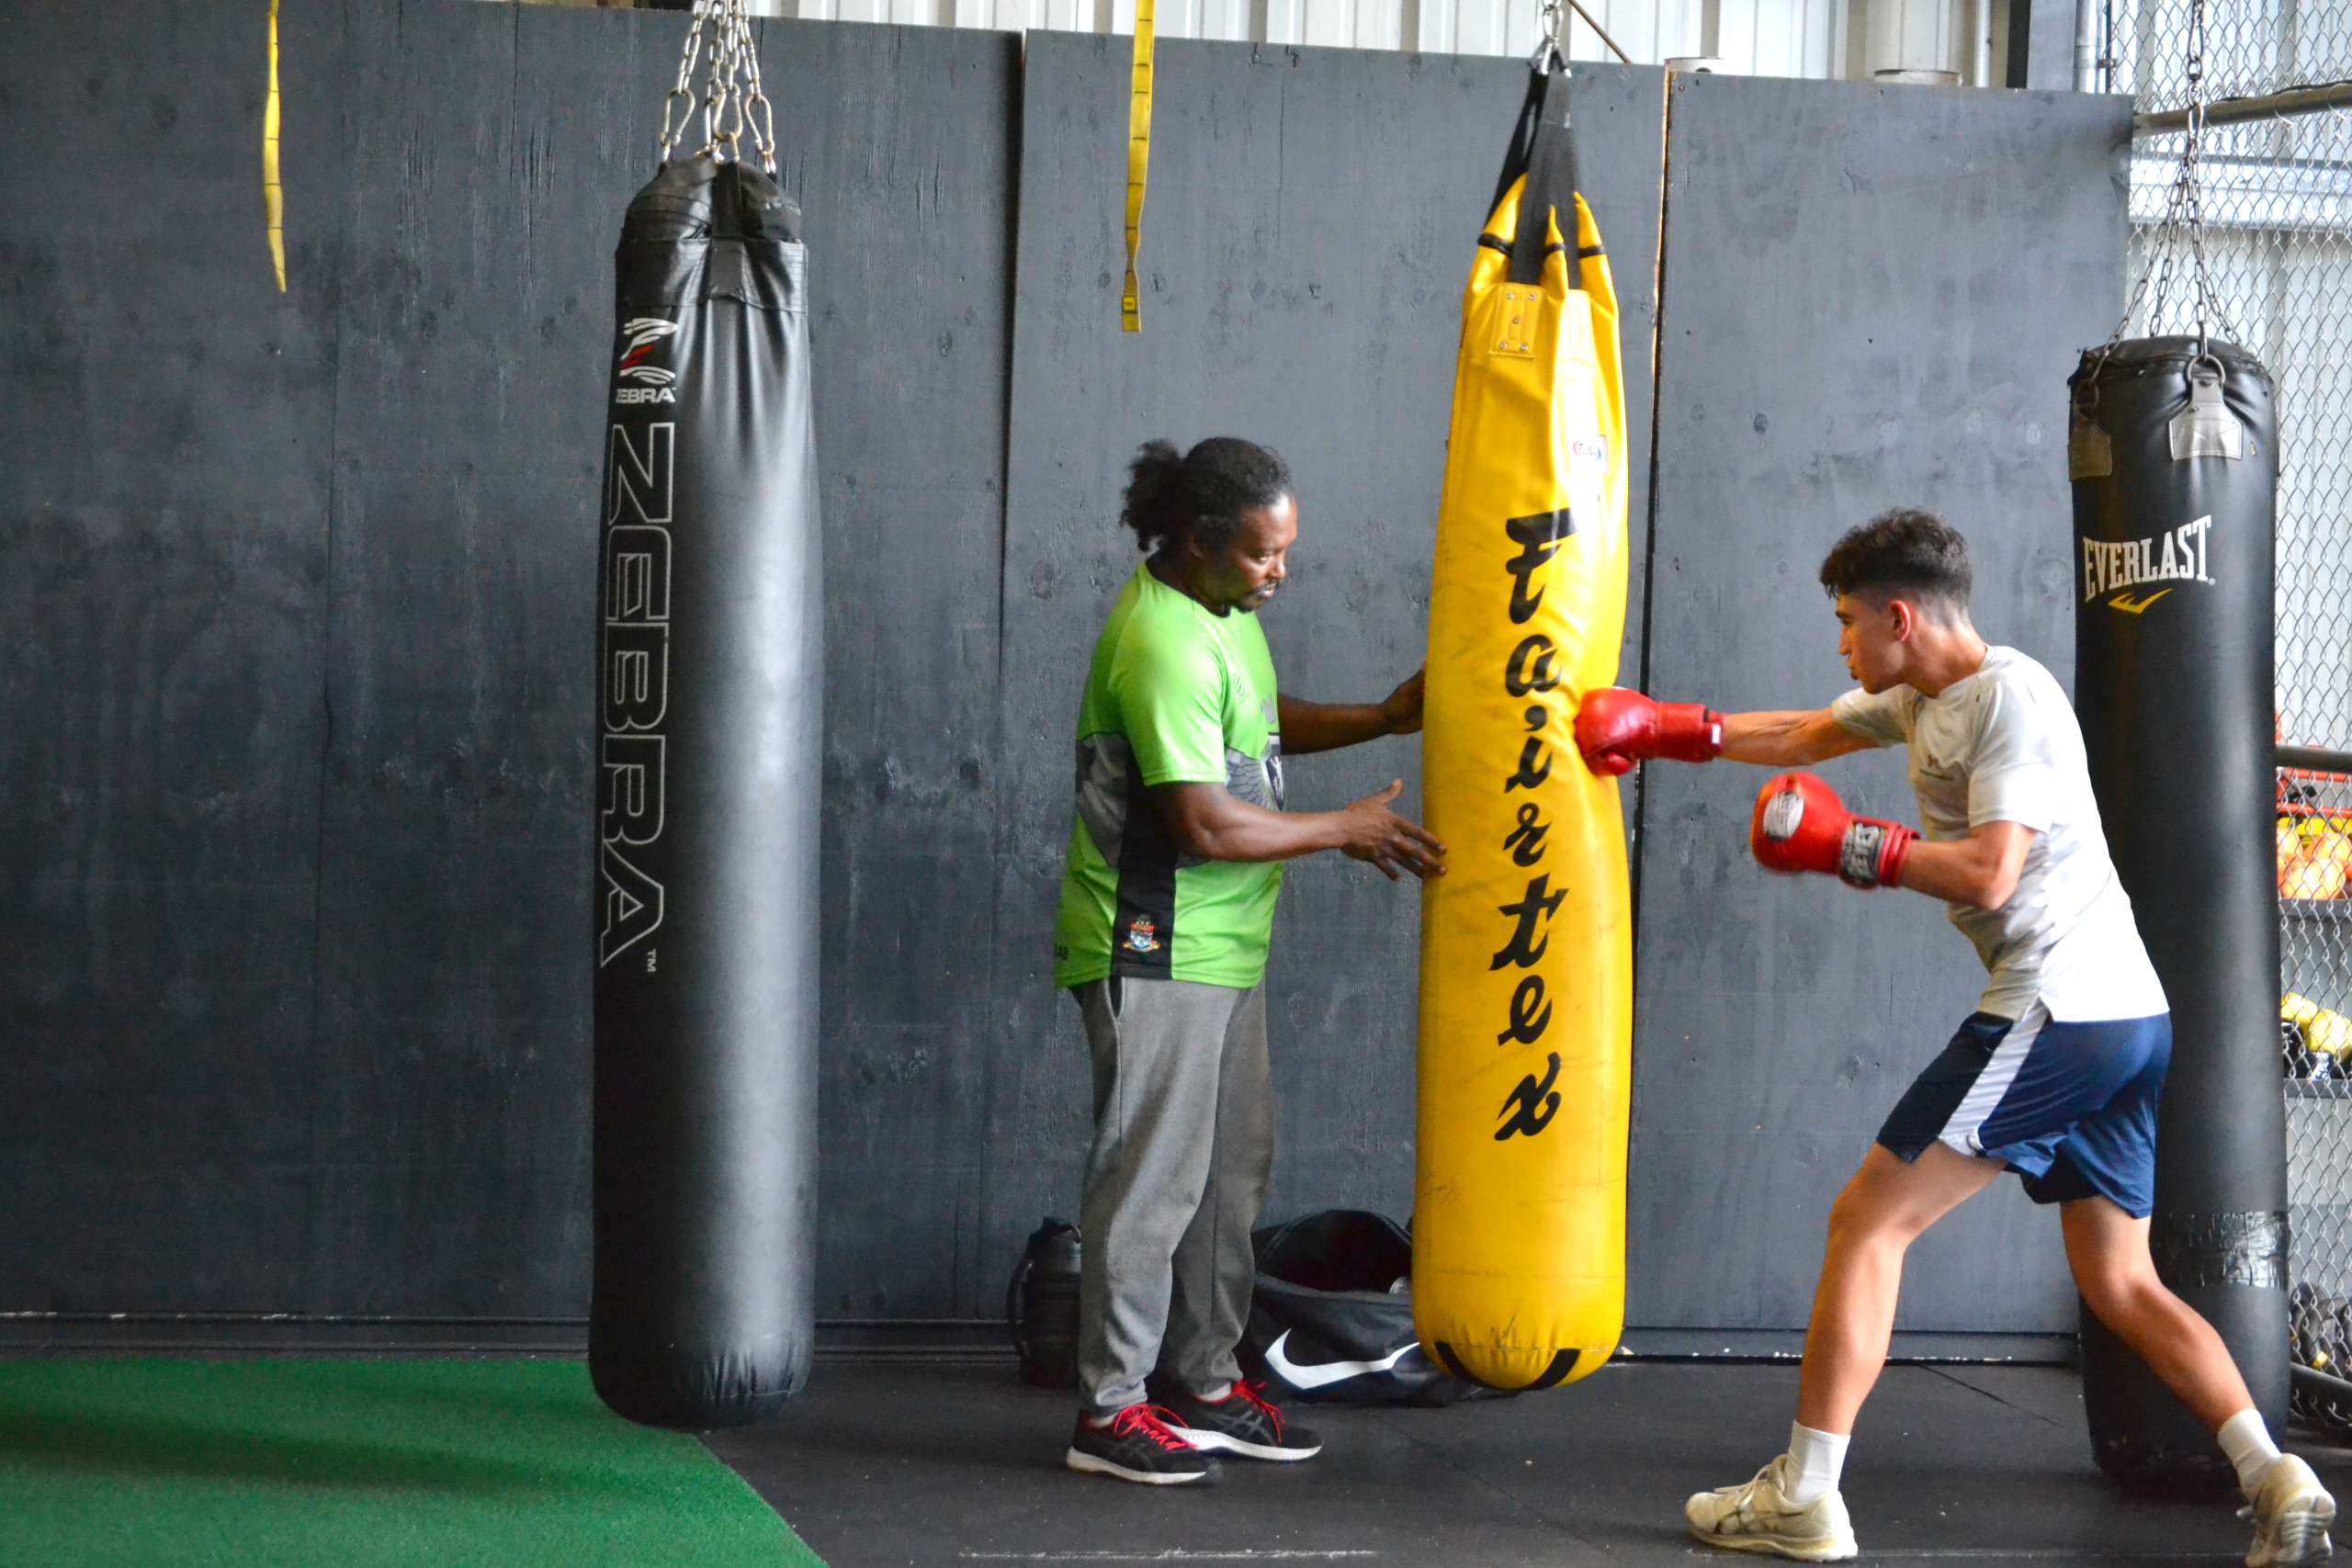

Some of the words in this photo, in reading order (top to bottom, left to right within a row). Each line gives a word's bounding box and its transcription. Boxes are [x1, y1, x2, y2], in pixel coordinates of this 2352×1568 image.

[600, 422, 675, 969] ZEBRA
[647, 948, 656, 973] TM
[1489, 507, 1579, 1143] Fairtex
[2082, 514, 2212, 604] EVERLAST
